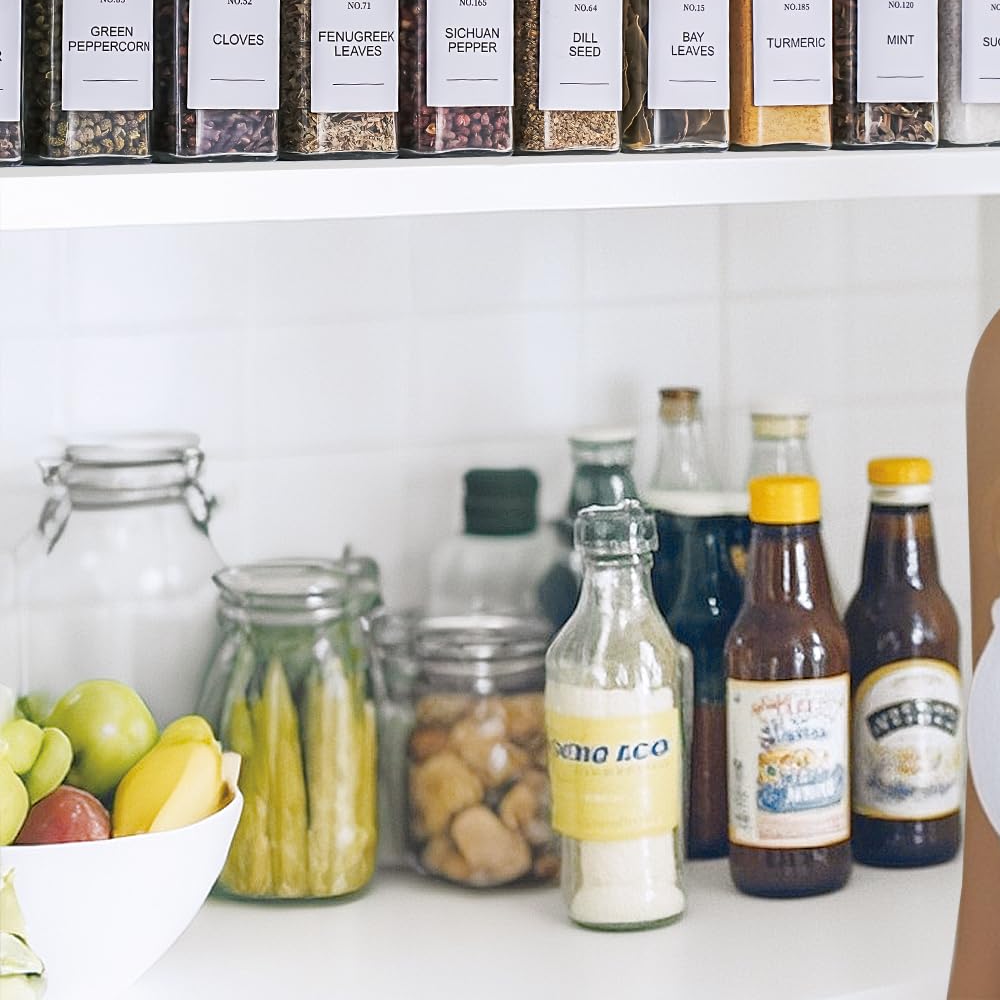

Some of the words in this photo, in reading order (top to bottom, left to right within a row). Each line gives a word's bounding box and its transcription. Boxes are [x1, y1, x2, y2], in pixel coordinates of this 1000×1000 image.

[574, 4, 597, 12] NO.64
[91, 26, 133, 37] GREEN
[319, 31, 394, 42] FENUGREEK
[445, 28, 499, 38] SICHUAN
[683, 32, 704, 42] BAY
[213, 34, 264, 45] CLOVES
[573, 32, 598, 43] DILL
[766, 37, 825, 48] TURMERIC
[887, 35, 914, 45] MINT
[69, 41, 149, 52] PEPPERCORN
[335, 46, 382, 56] LEAVES
[449, 42, 497, 52] PEPPER
[569, 46, 601, 57] SEED
[672, 45, 714, 56] LEAVES
